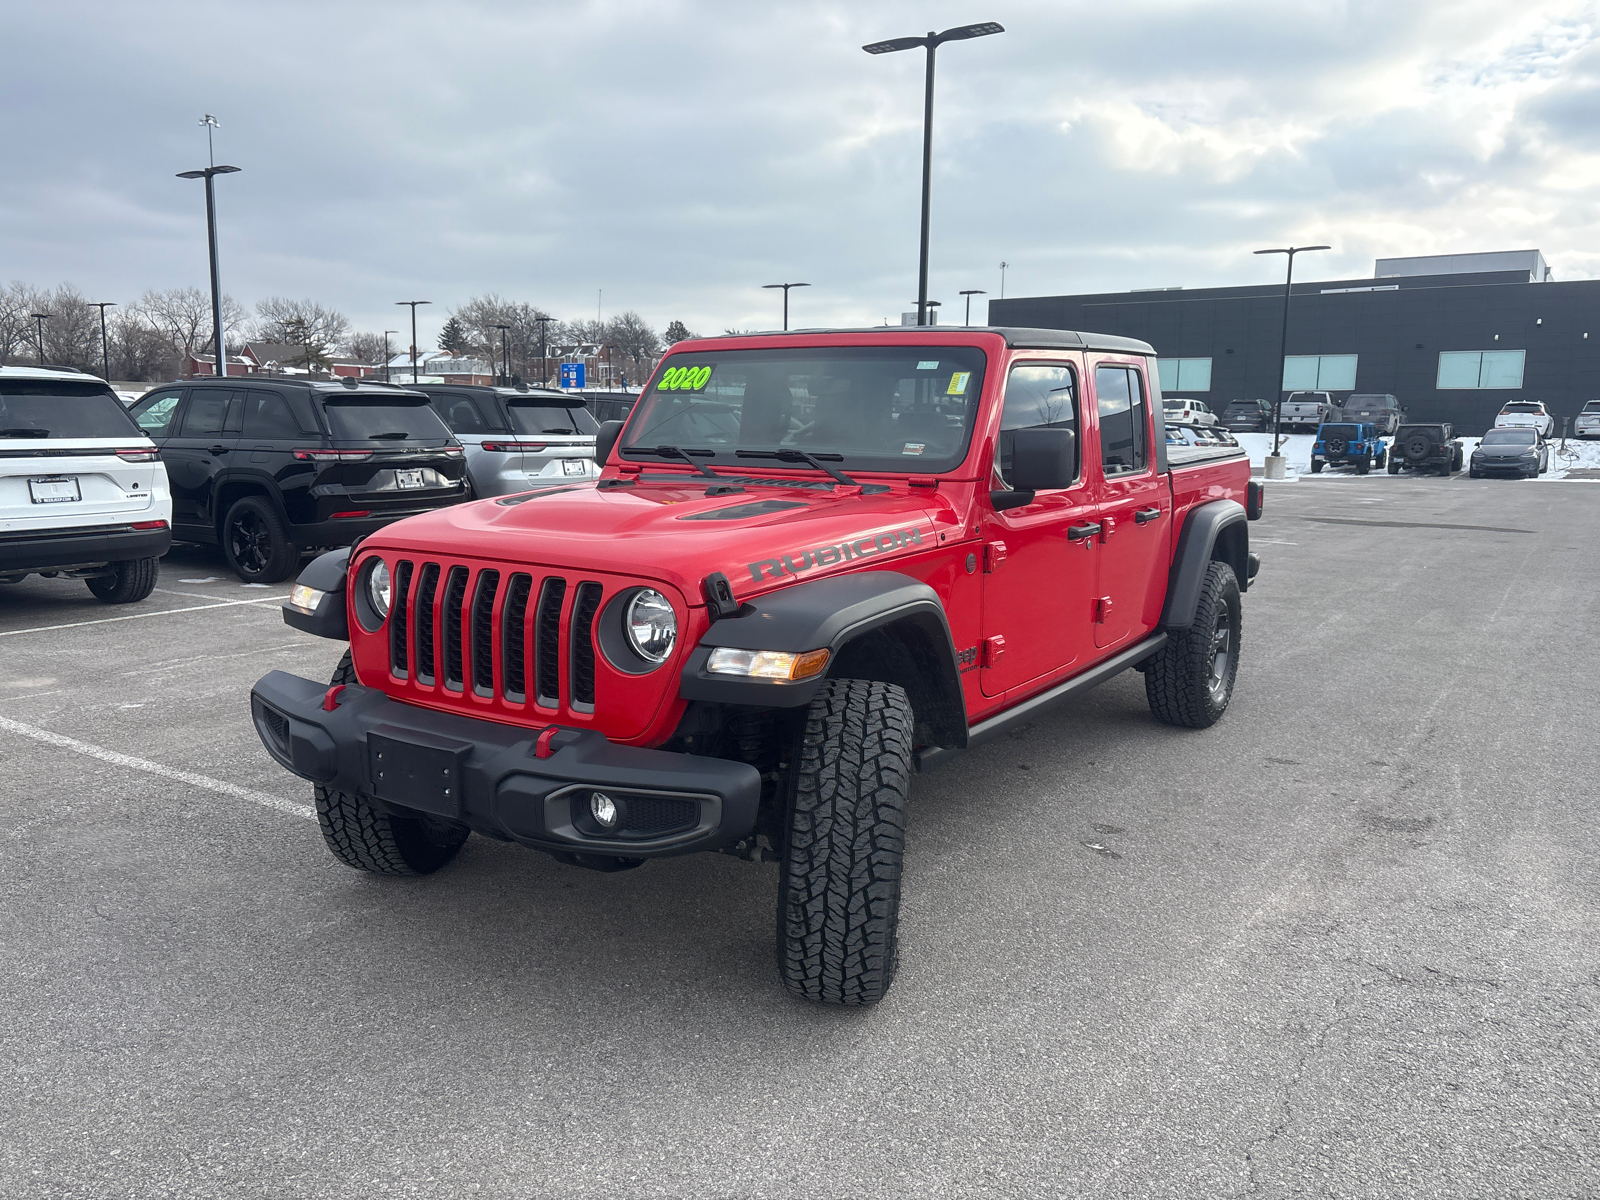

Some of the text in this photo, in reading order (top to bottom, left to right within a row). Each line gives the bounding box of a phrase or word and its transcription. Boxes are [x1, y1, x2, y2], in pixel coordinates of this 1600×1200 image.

[657, 366, 712, 391] 2020
[747, 527, 923, 583] RUBICON
[954, 646, 978, 665] eep
